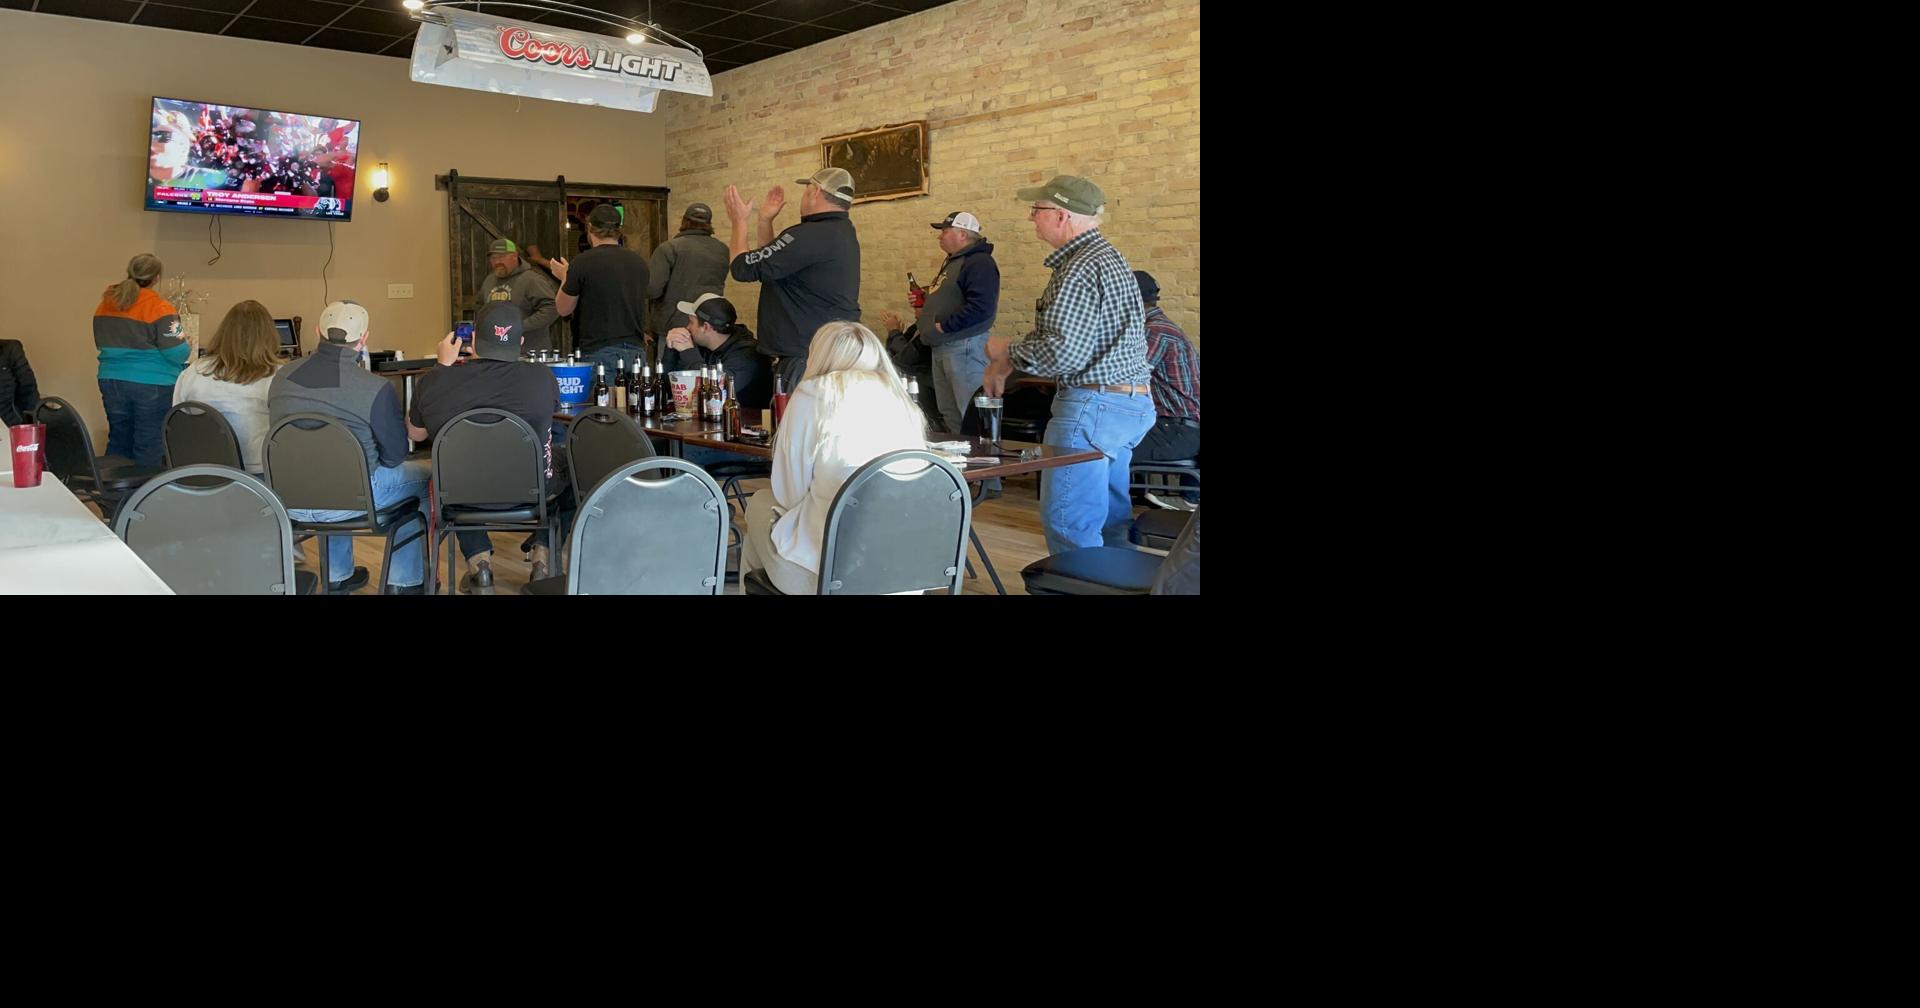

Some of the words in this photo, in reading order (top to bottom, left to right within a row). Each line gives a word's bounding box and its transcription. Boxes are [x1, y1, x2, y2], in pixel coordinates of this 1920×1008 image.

[497, 26, 593, 69] Coors
[594, 49, 682, 81] LIGHT
[556, 377, 582, 386] BUD
[558, 385, 585, 394] IGHT
